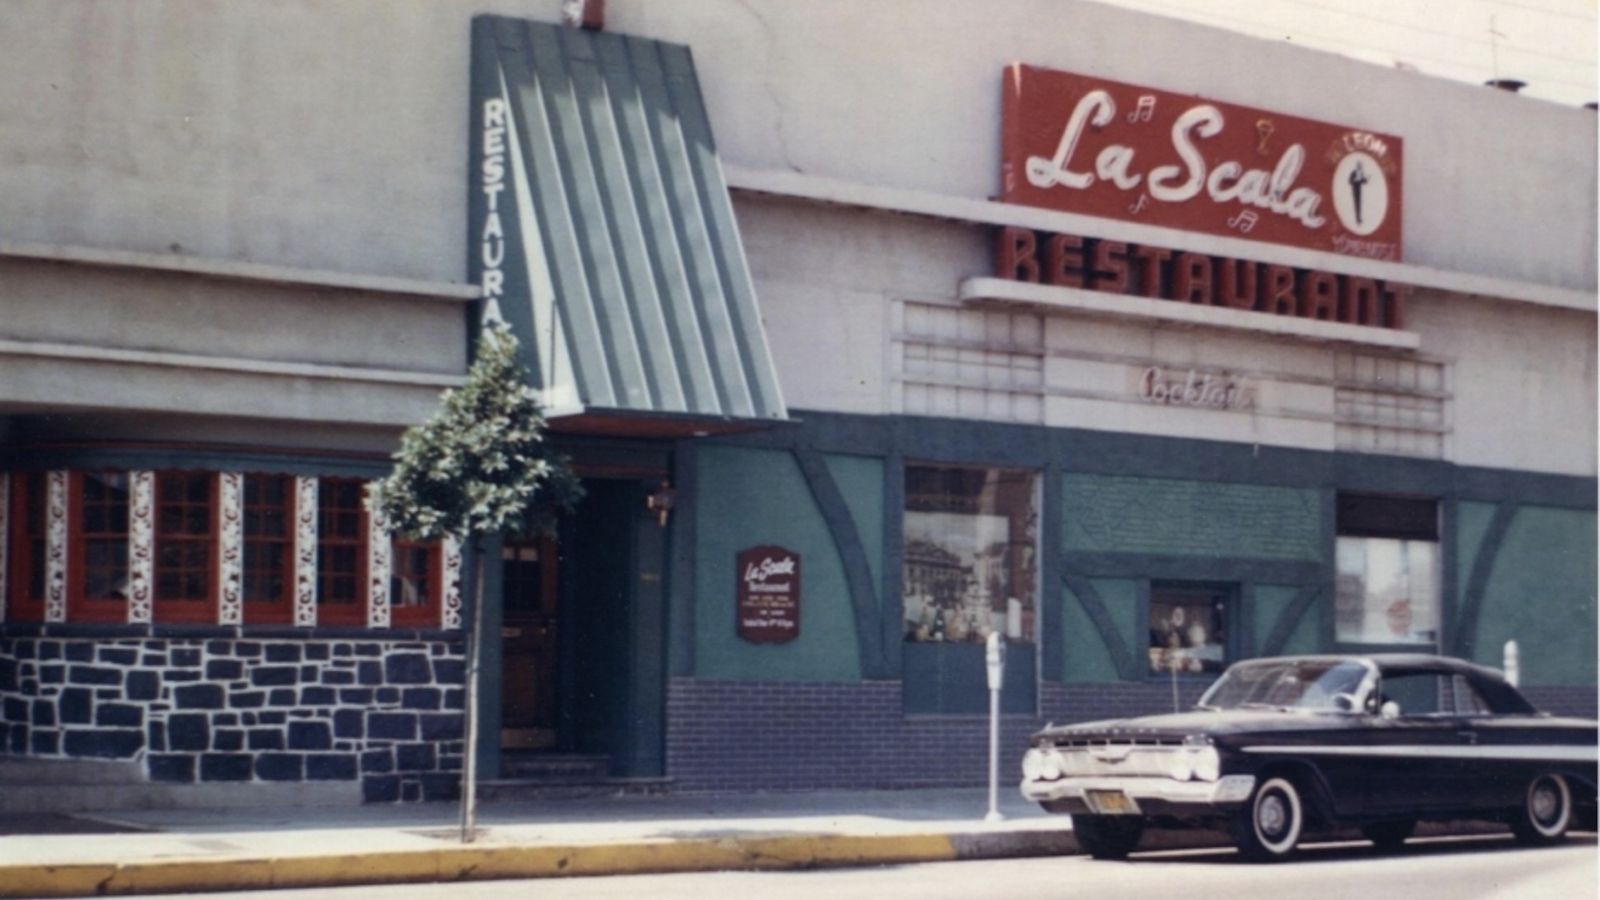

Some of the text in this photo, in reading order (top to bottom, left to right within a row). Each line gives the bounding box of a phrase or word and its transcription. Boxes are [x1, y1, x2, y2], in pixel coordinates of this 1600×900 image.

[483, 98, 505, 350] RESTAURA
[1026, 89, 1326, 229] La Scala
[1001, 227, 1413, 329] RESTAURANT
